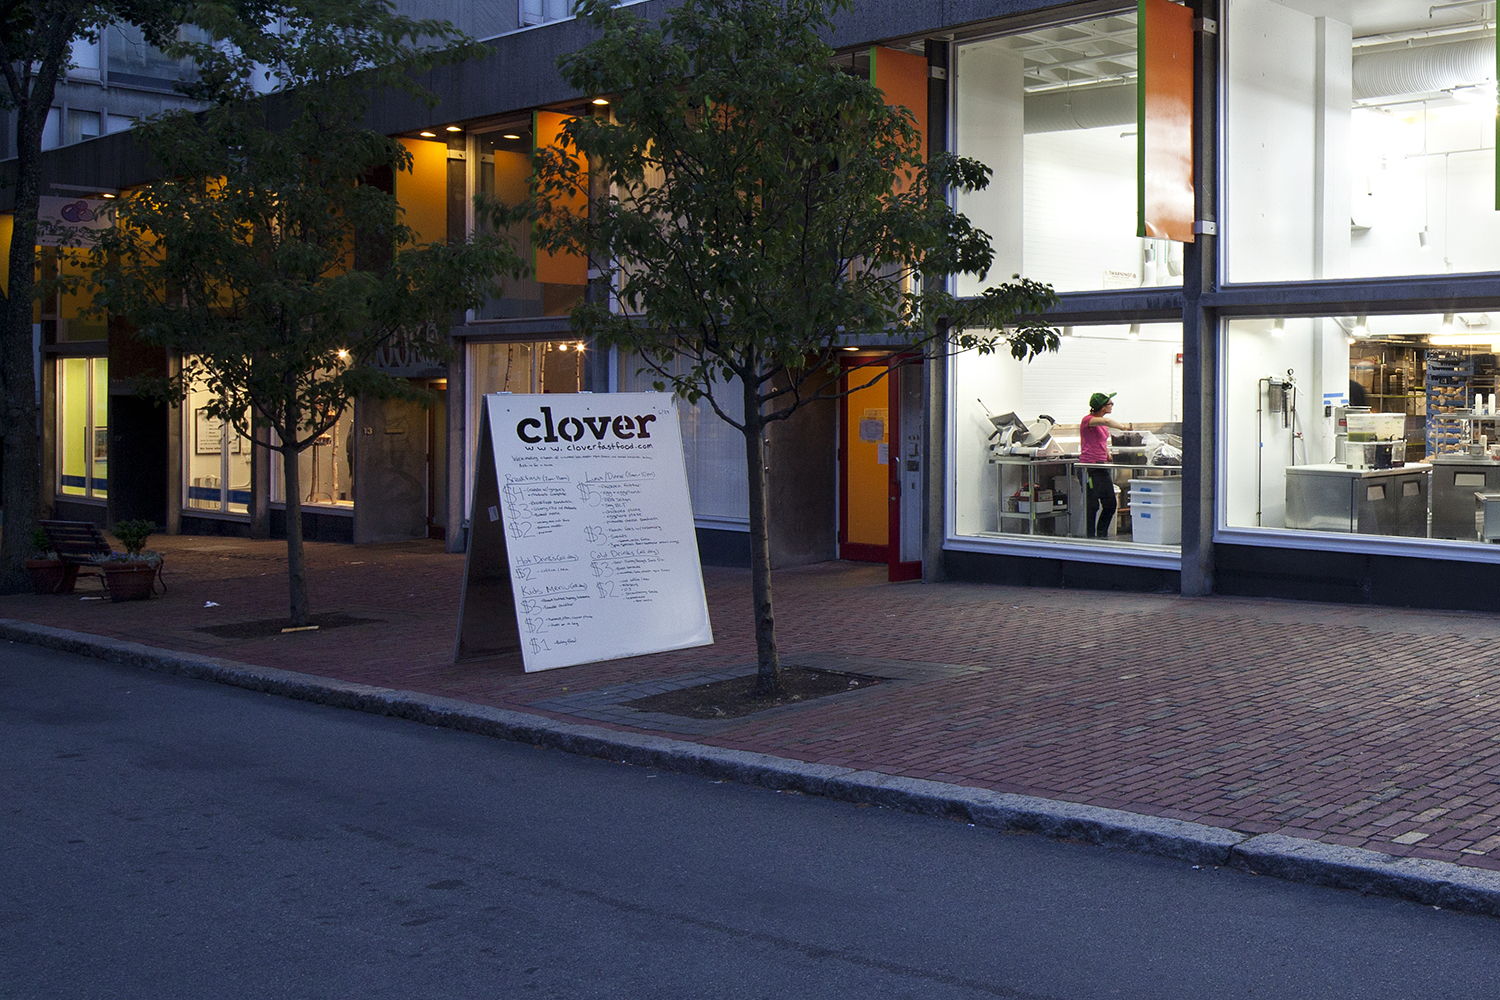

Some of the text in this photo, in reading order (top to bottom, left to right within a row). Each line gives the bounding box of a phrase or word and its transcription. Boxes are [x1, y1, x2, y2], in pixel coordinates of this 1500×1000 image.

[363, 427, 373, 435] 13
[516, 406, 657, 443] clover
[505, 474, 541, 483] Breakfast
[502, 485, 524, 503] $4
[576, 481, 602, 507] $5
[507, 503, 533, 520] $3
[509, 521, 535, 540] $2
[583, 525, 608, 546] $3
[515, 556, 531, 565] Hot
[590, 550, 608, 559] Cold
[515, 567, 537, 581] $2
[590, 562, 614, 577] $3
[596, 580, 619, 599] $2
[520, 599, 542, 615] $3
[525, 617, 548, 634] $2
[529, 637, 552, 655] $1
